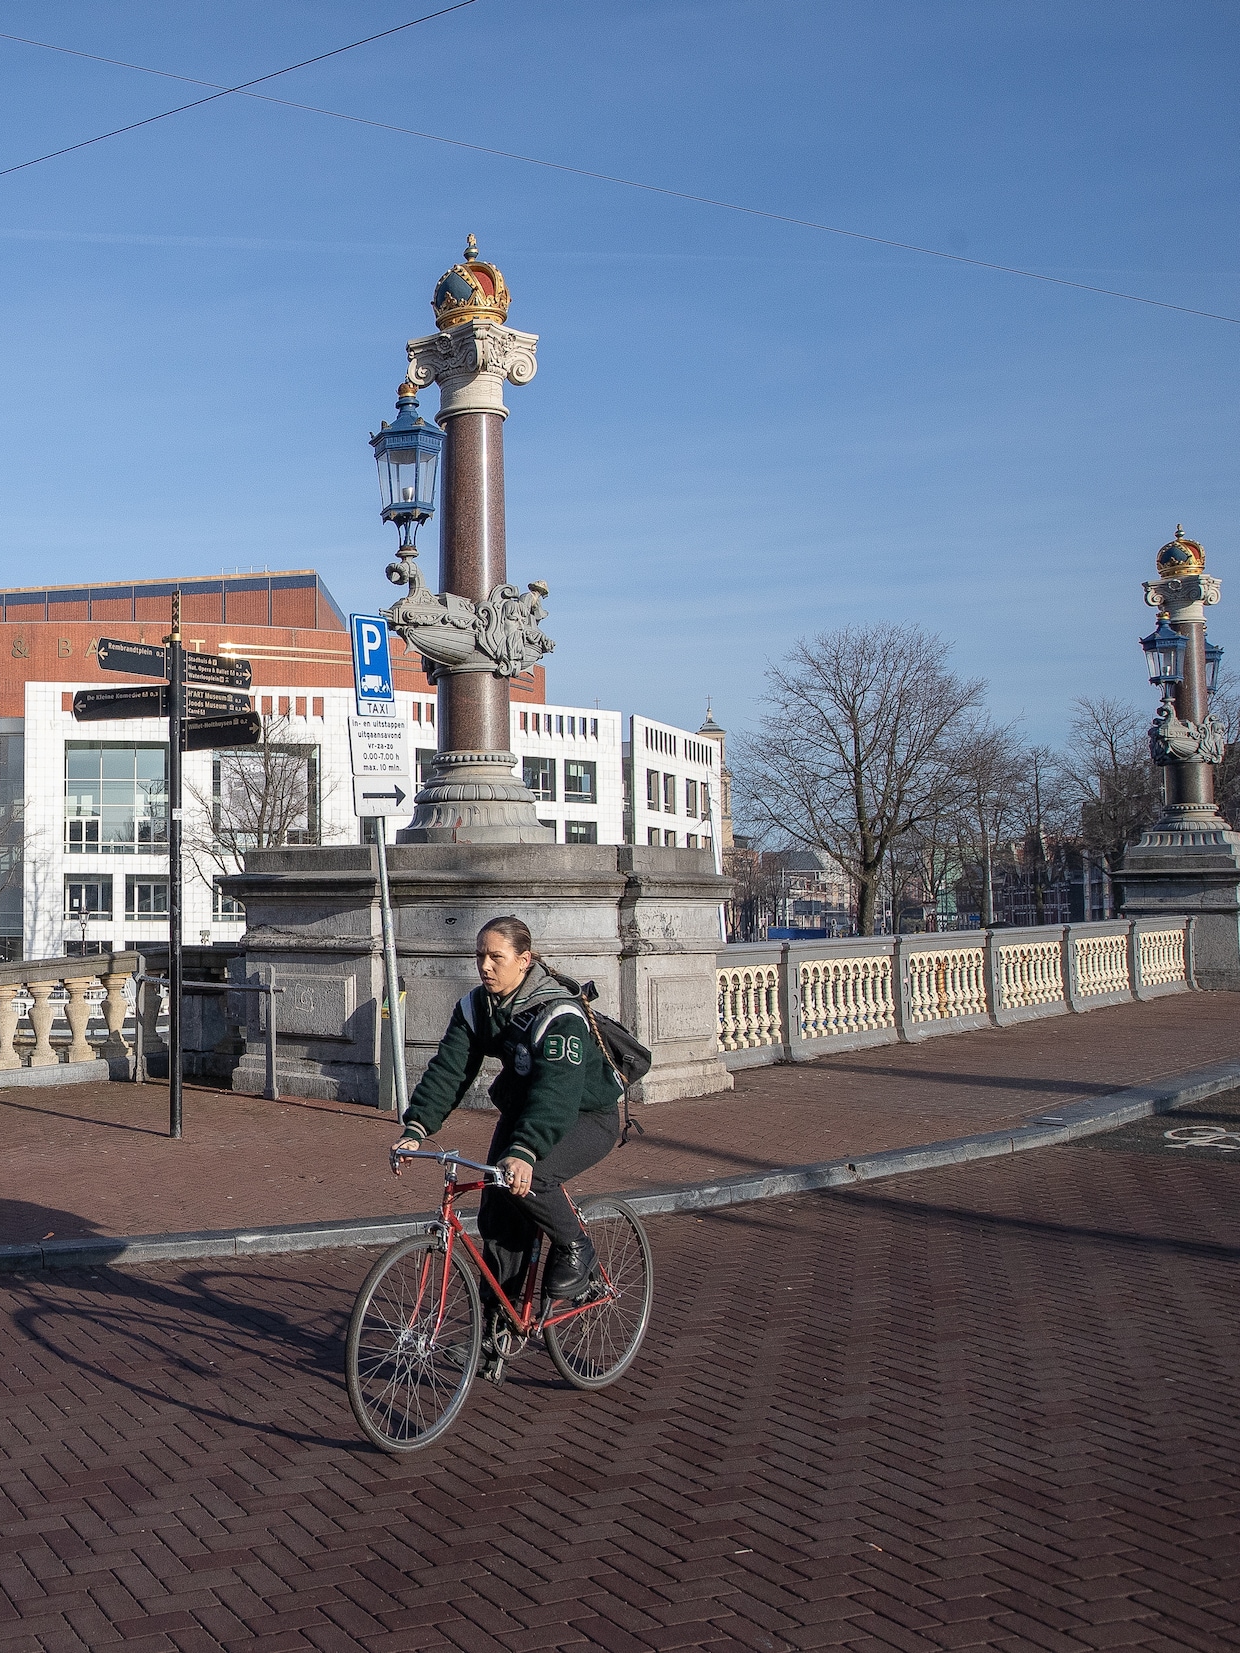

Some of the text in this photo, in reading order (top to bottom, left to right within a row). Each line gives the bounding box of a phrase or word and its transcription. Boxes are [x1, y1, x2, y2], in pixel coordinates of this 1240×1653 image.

[12, 636, 30, 659] &
[108, 642, 153, 656] Rembrandtplein
[362, 623, 381, 665] P
[116, 691, 141, 699] Komedie
[205, 692, 227, 701] Museum
[188, 699, 204, 707] Joods
[205, 701, 227, 710] Museum
[367, 703, 389, 714] TAXI
[373, 720, 405, 729] uitstappen
[358, 730, 401, 740] uitgaansavond
[363, 752, 394, 760] 0.00-7.00
[544, 1034, 583, 1065] 89
